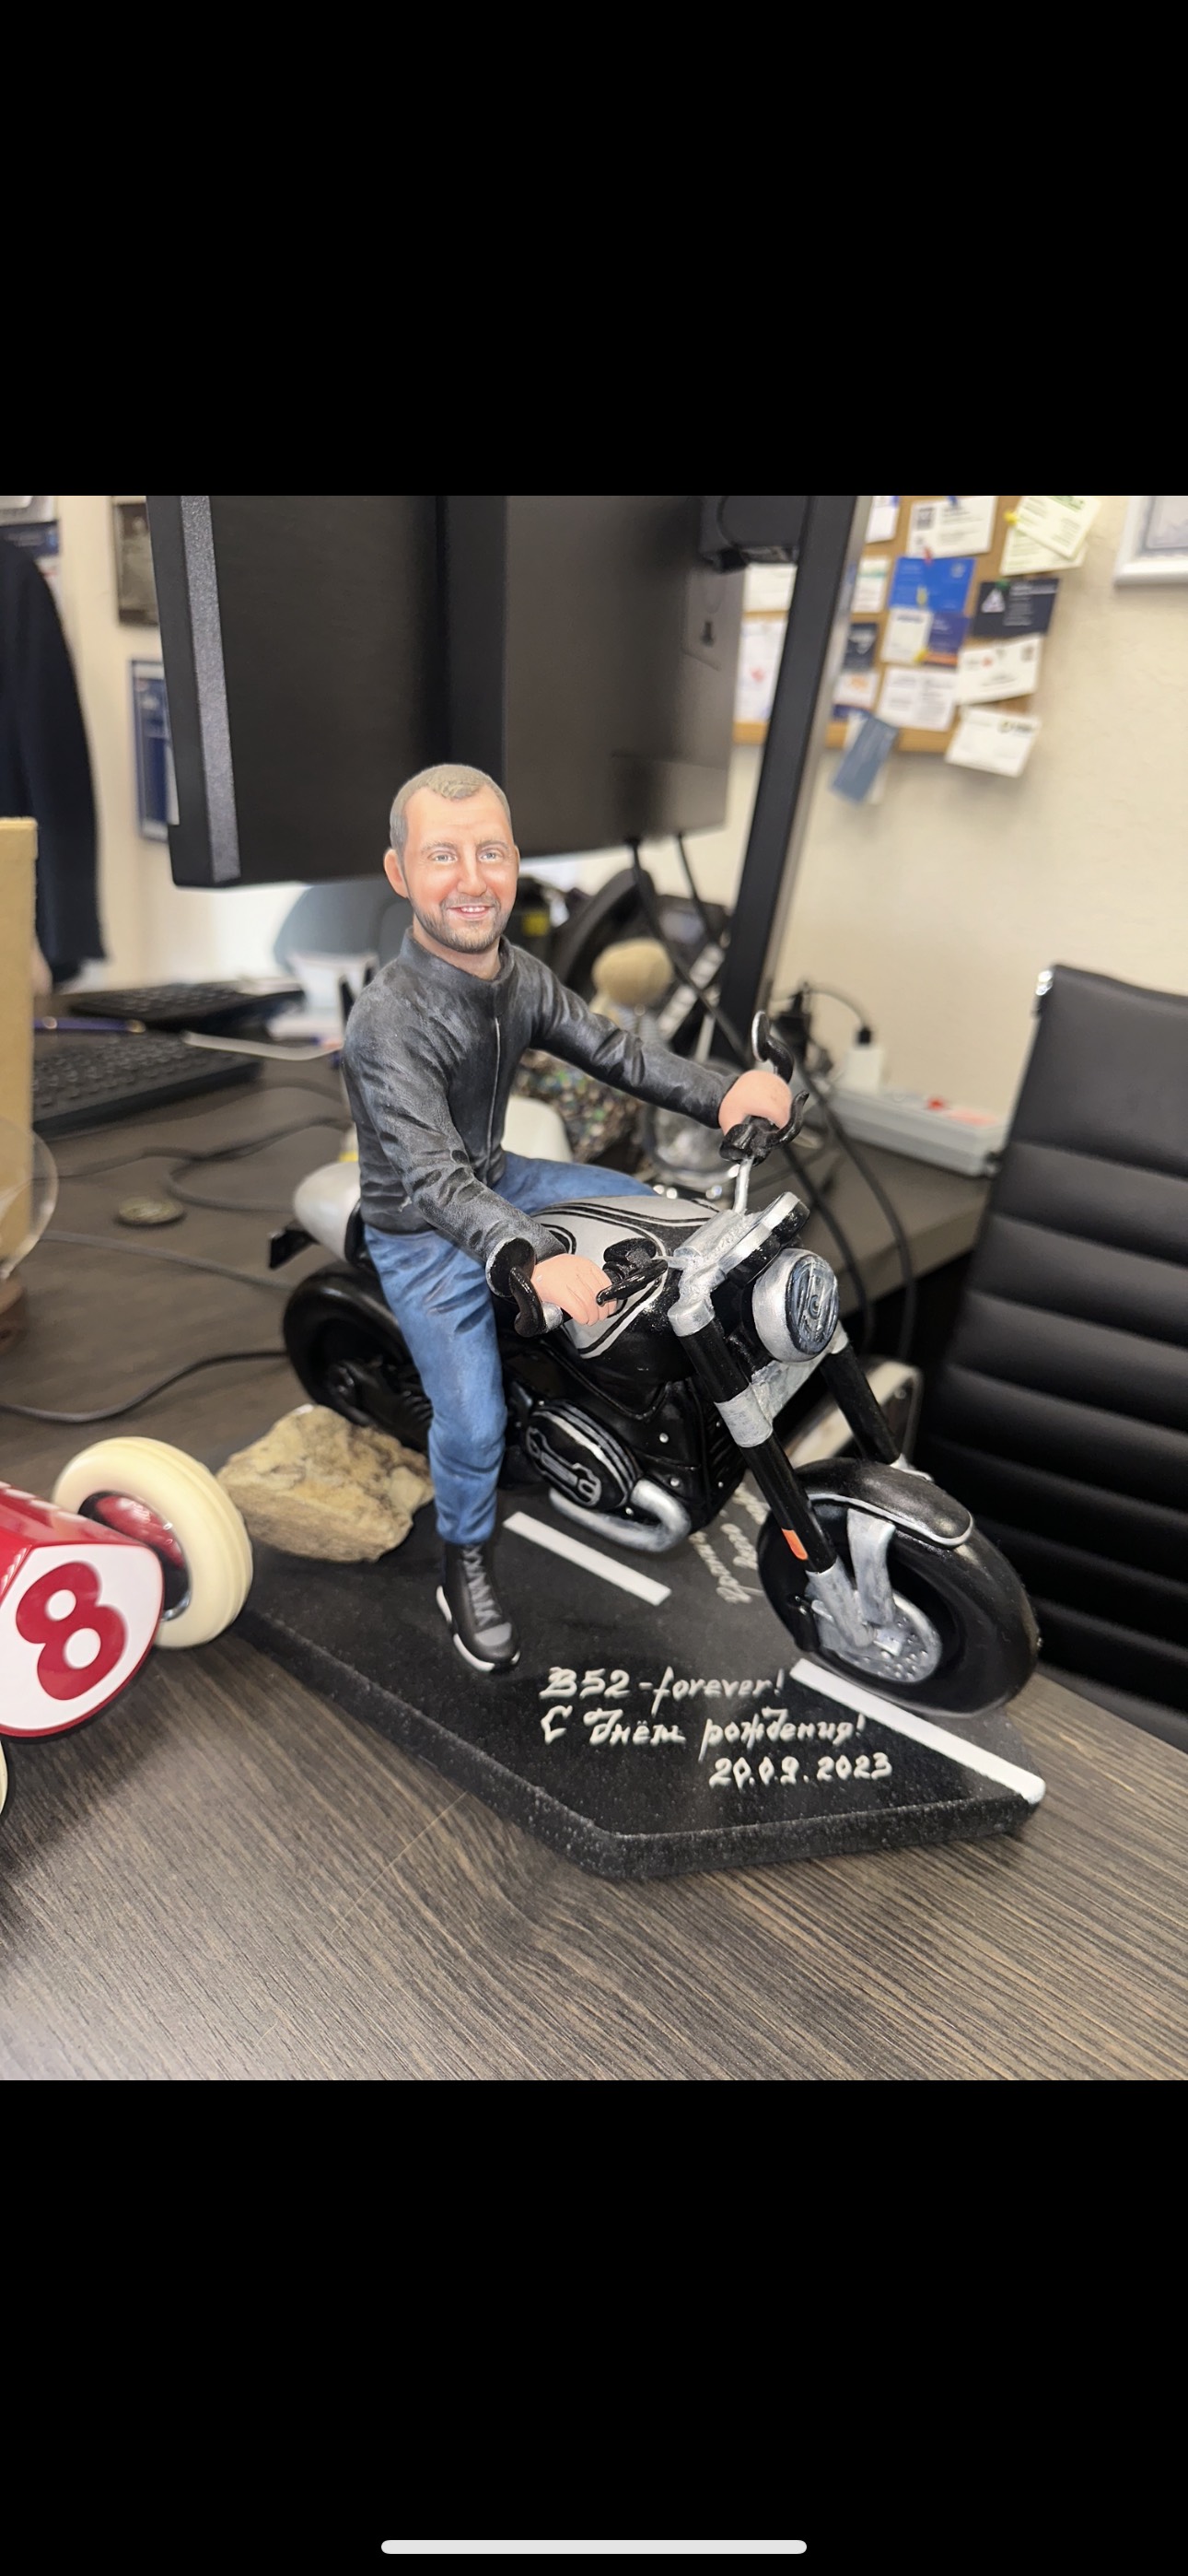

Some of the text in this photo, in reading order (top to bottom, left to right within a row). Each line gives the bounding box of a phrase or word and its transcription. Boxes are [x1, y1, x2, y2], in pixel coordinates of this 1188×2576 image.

[16, 1560, 127, 1702] 8
[541, 1704, 867, 1763] С Днём рождения!
